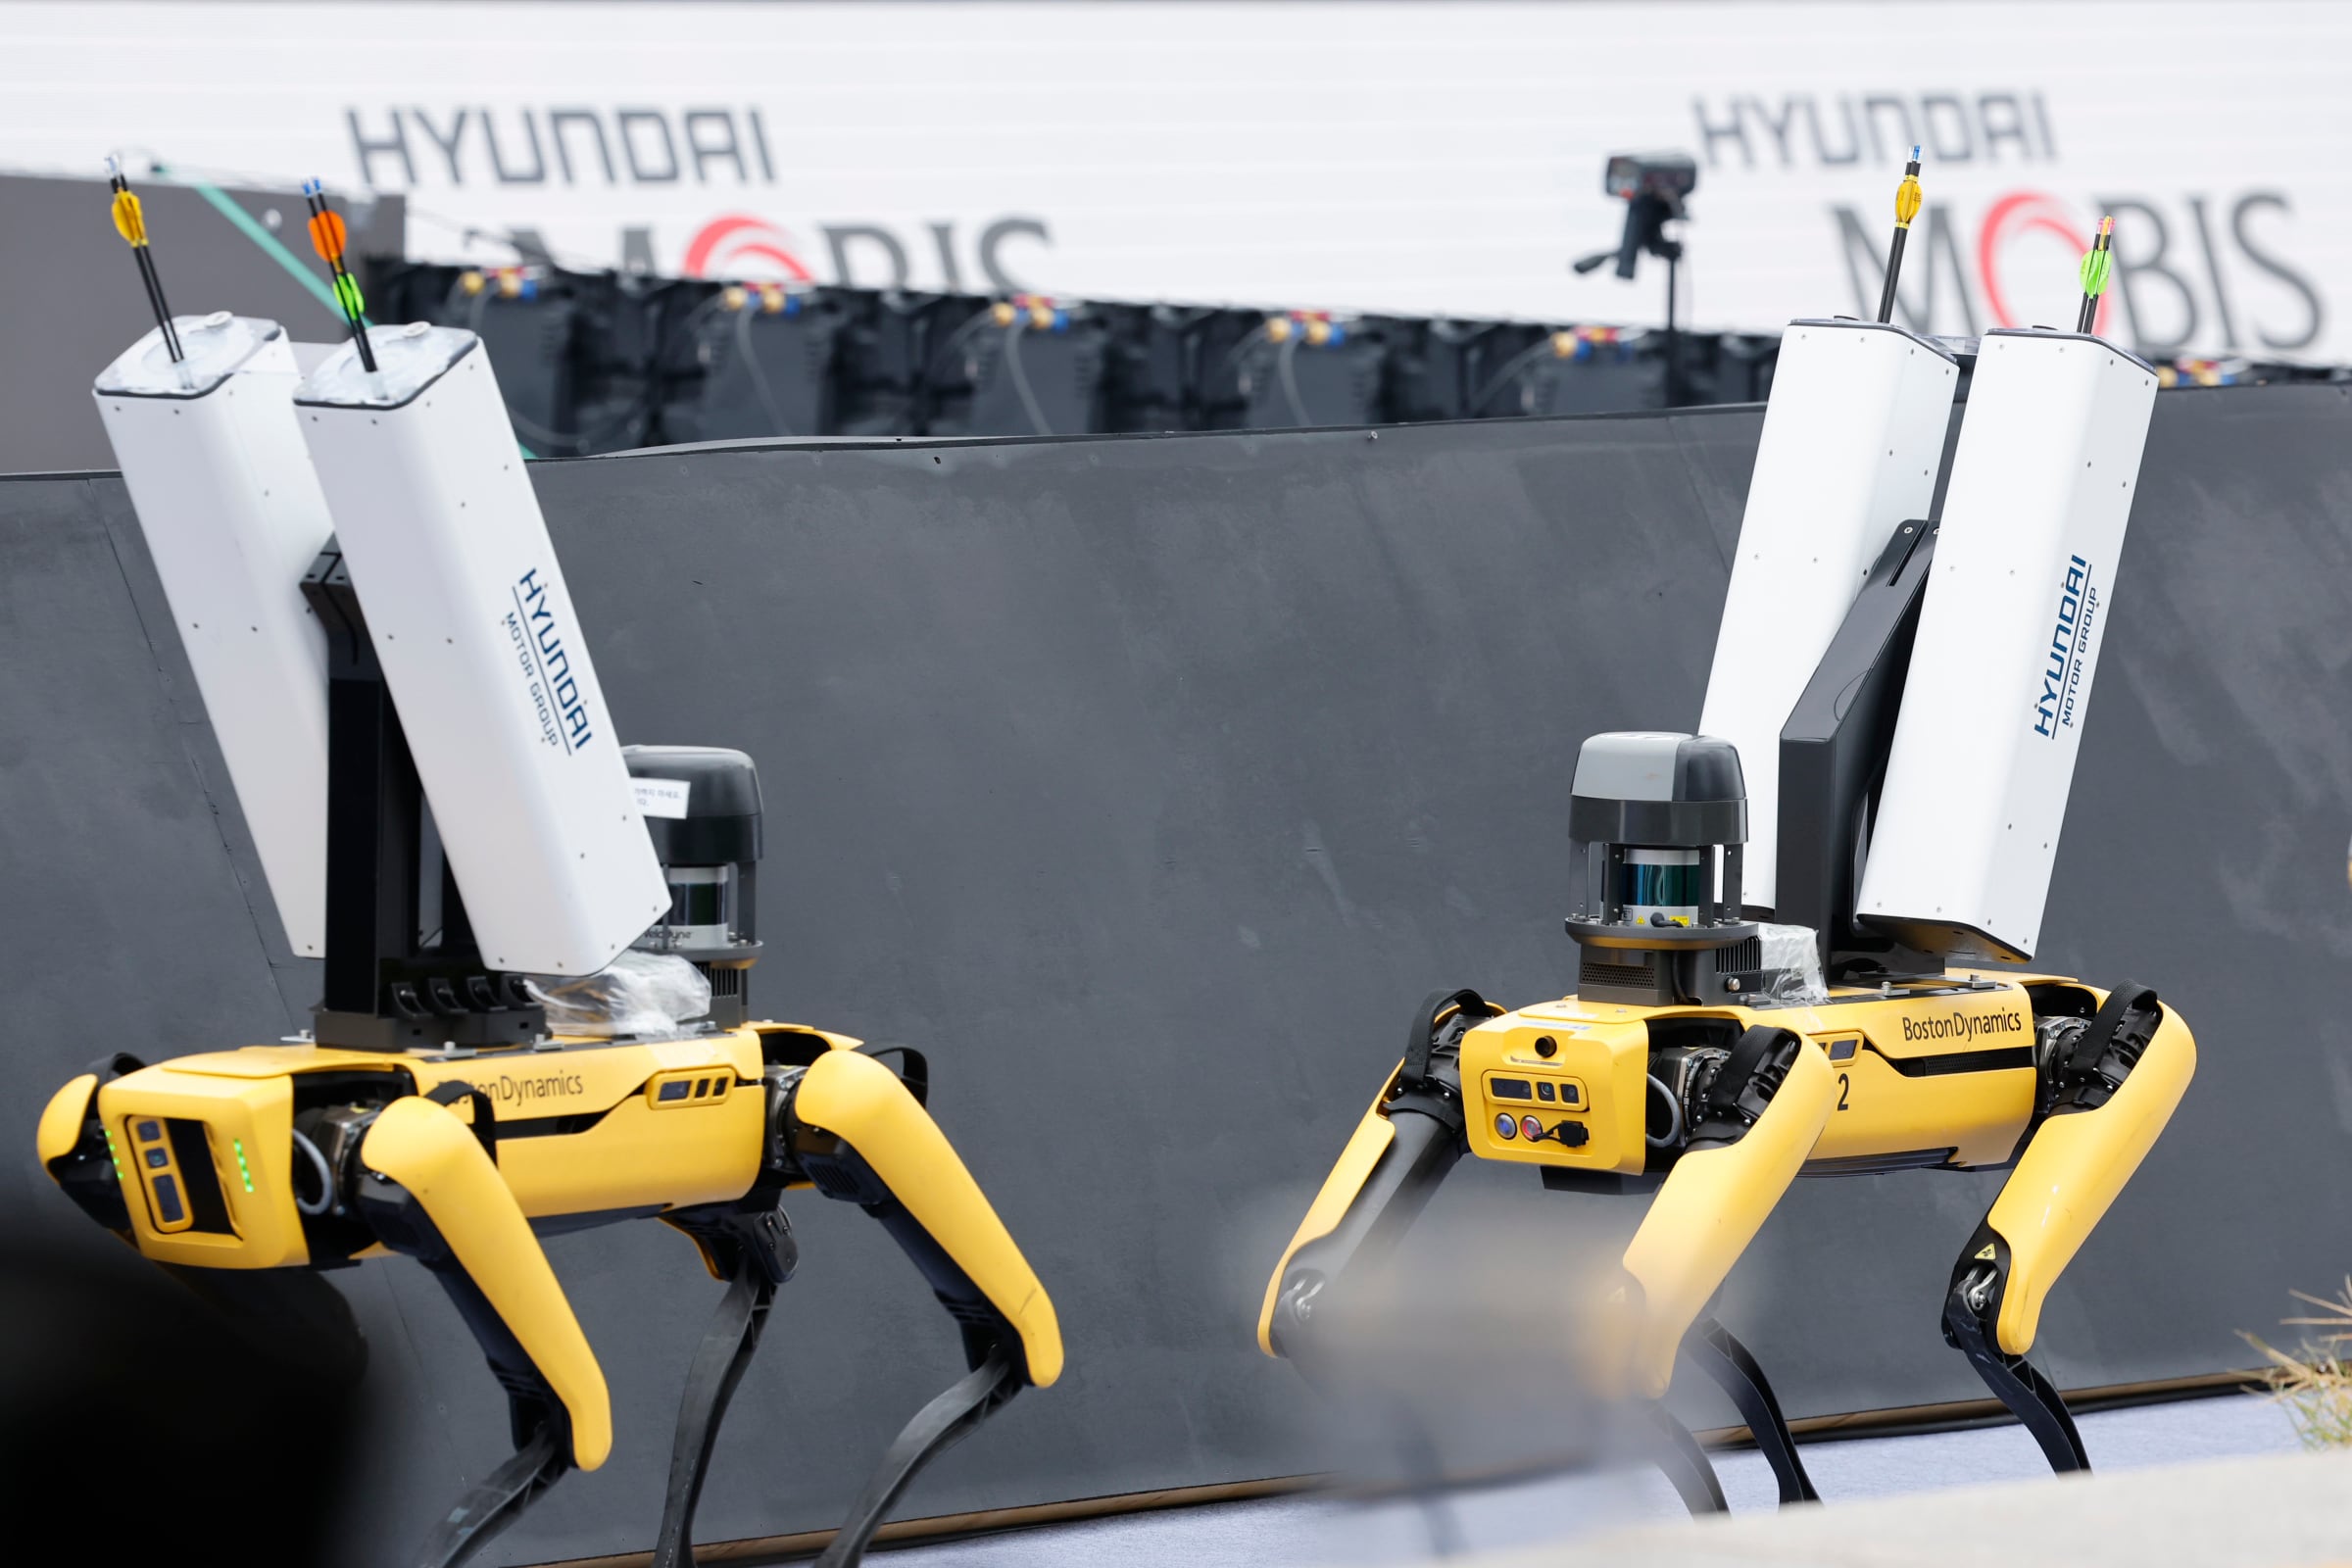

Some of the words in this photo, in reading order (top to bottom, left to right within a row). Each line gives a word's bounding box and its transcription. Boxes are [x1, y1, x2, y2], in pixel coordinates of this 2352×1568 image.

[346, 108, 776, 184] HYUNDAI
[1690, 90, 2057, 167] HYUNDAI
[1825, 186, 2323, 351] MOBIS
[506, 611, 535, 678] MOTOR
[529, 681, 559, 747] GROUP
[519, 567, 593, 751] HYUNDAI
[2034, 554, 2087, 738] HYUNDAI
[2061, 658, 2083, 726] MOTOR
[2077, 586, 2098, 655] GROUP
[1837, 1073, 1849, 1111] 2
[1902, 1006, 2023, 1043] BostonDynamics
